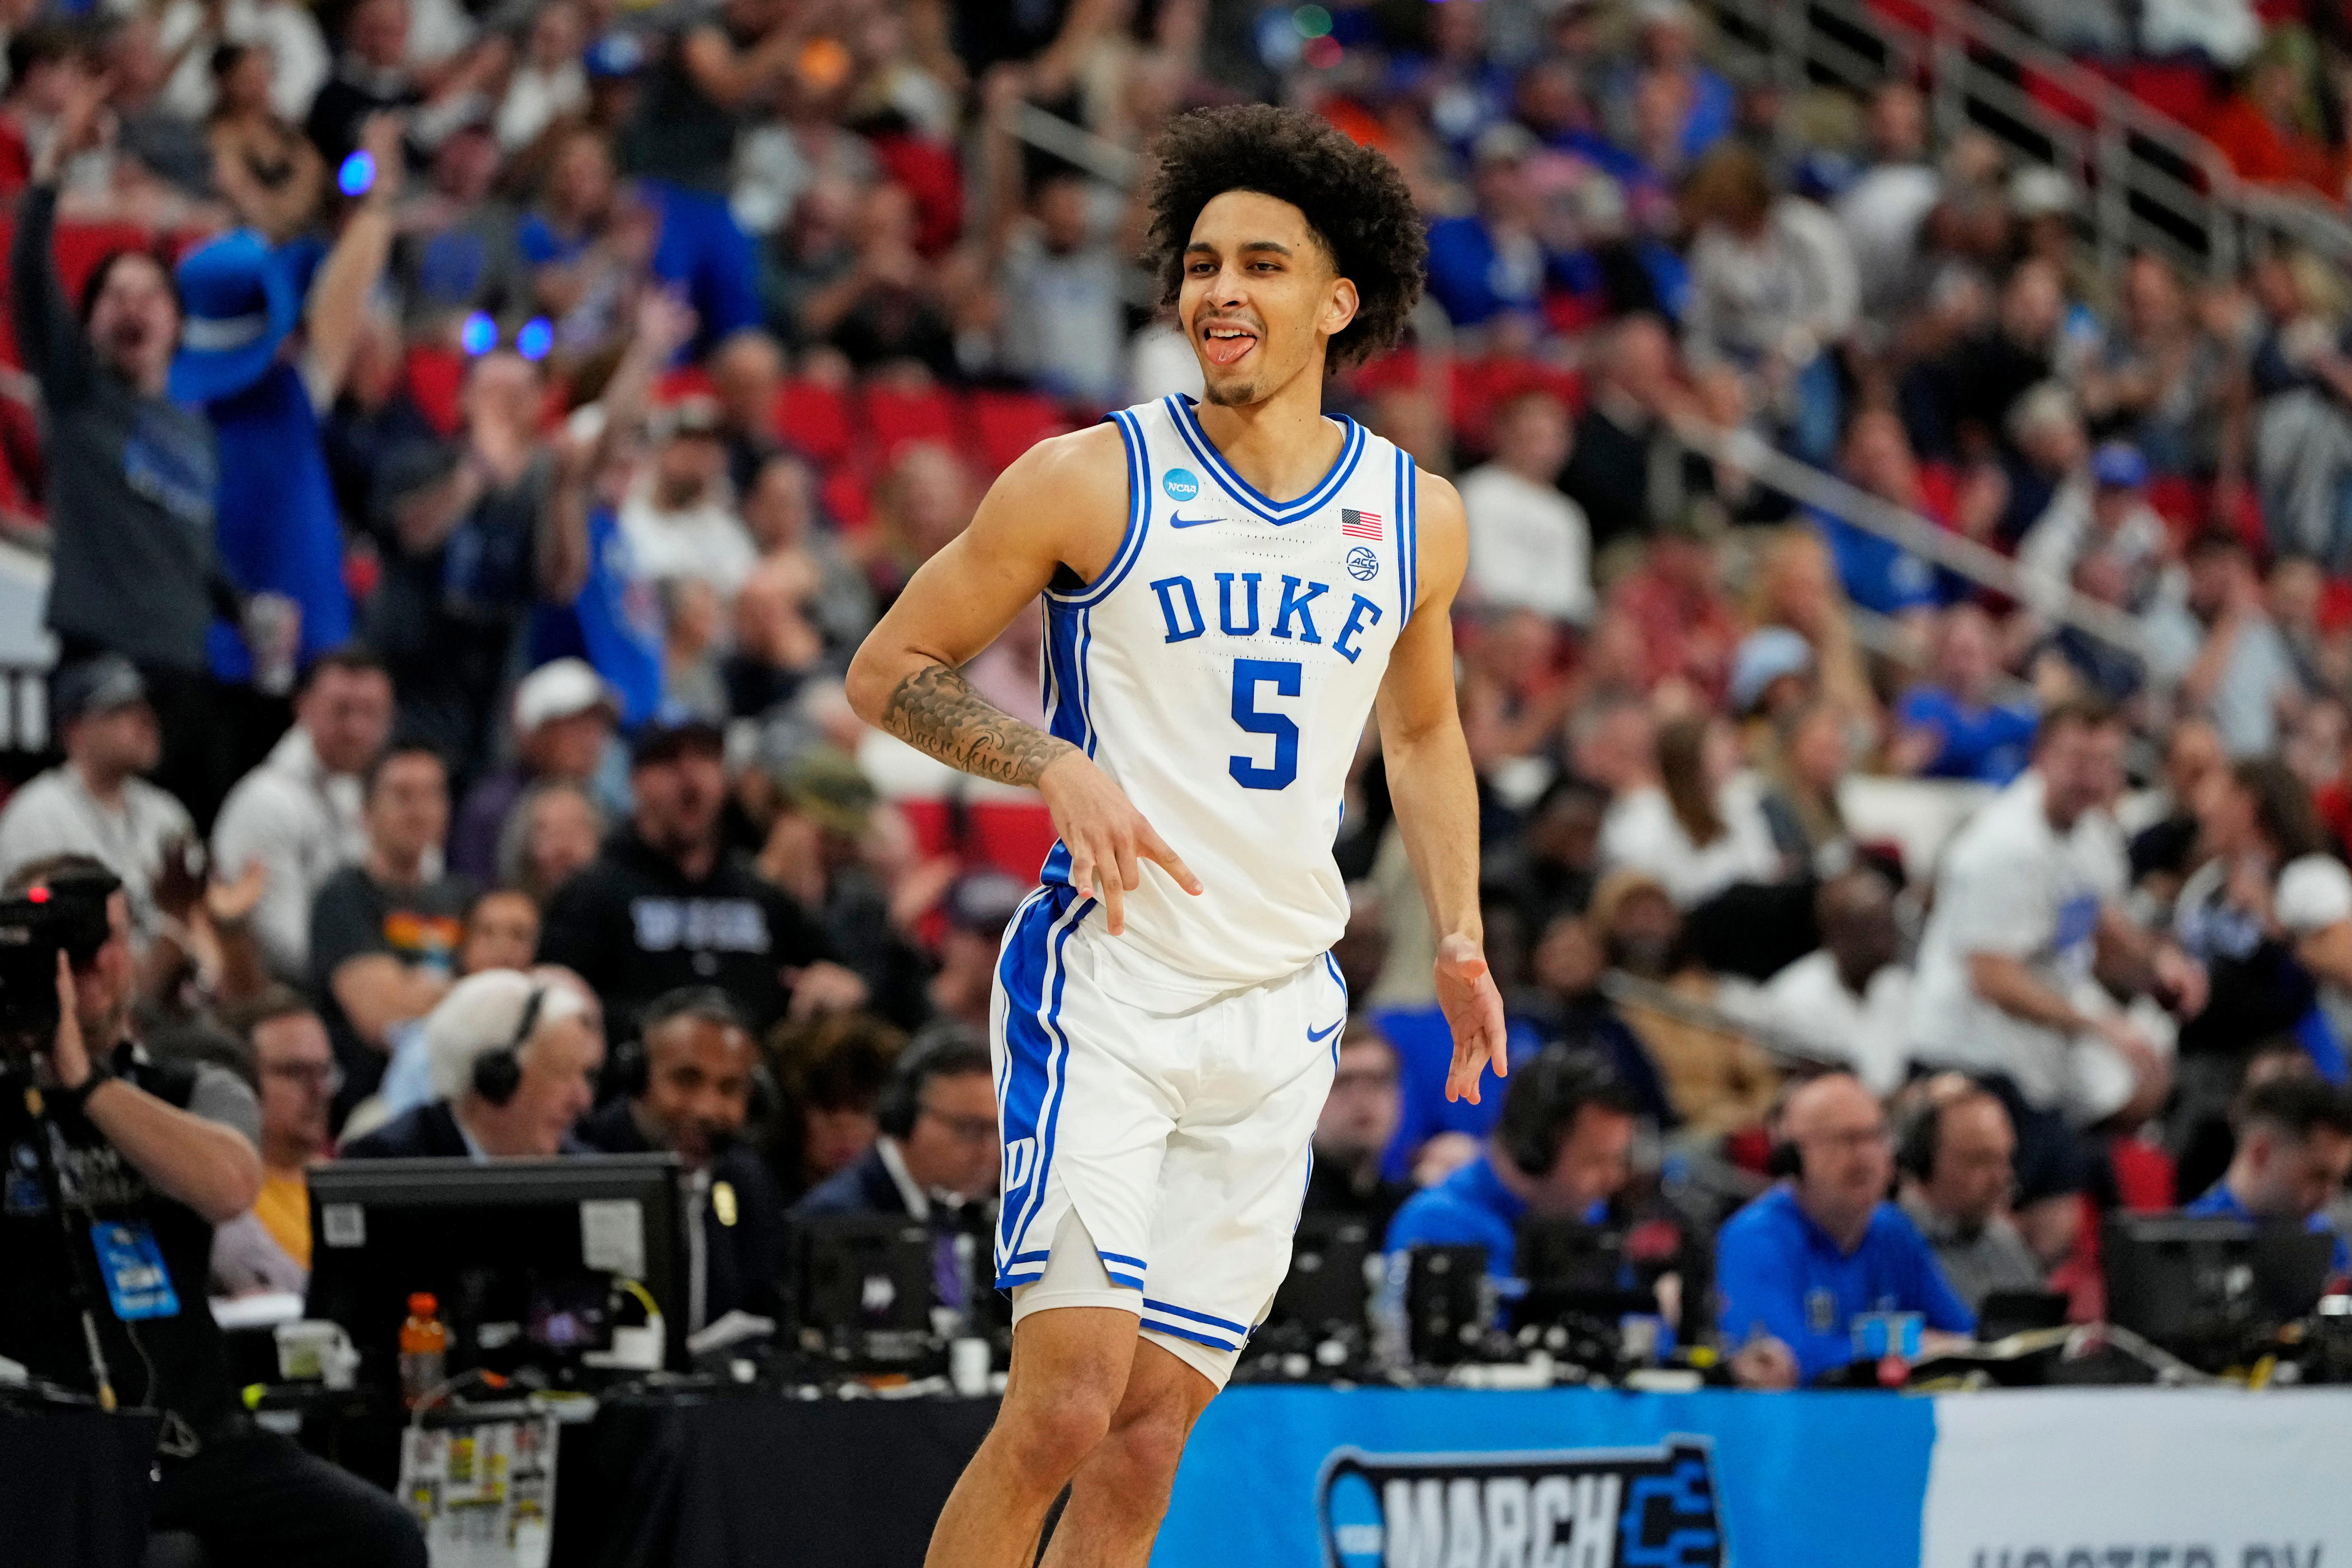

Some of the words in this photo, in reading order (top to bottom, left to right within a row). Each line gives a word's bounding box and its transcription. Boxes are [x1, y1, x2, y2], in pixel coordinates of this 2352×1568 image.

[1168, 482, 1196, 493] NCAA
[1351, 558, 1377, 569] ACC
[1149, 572, 1383, 664] DUKE
[893, 709, 1025, 780] Sacrifice
[1229, 659, 1302, 790] 5
[1007, 1137, 1035, 1192] D
[1383, 1474, 1622, 1568] MARCH
